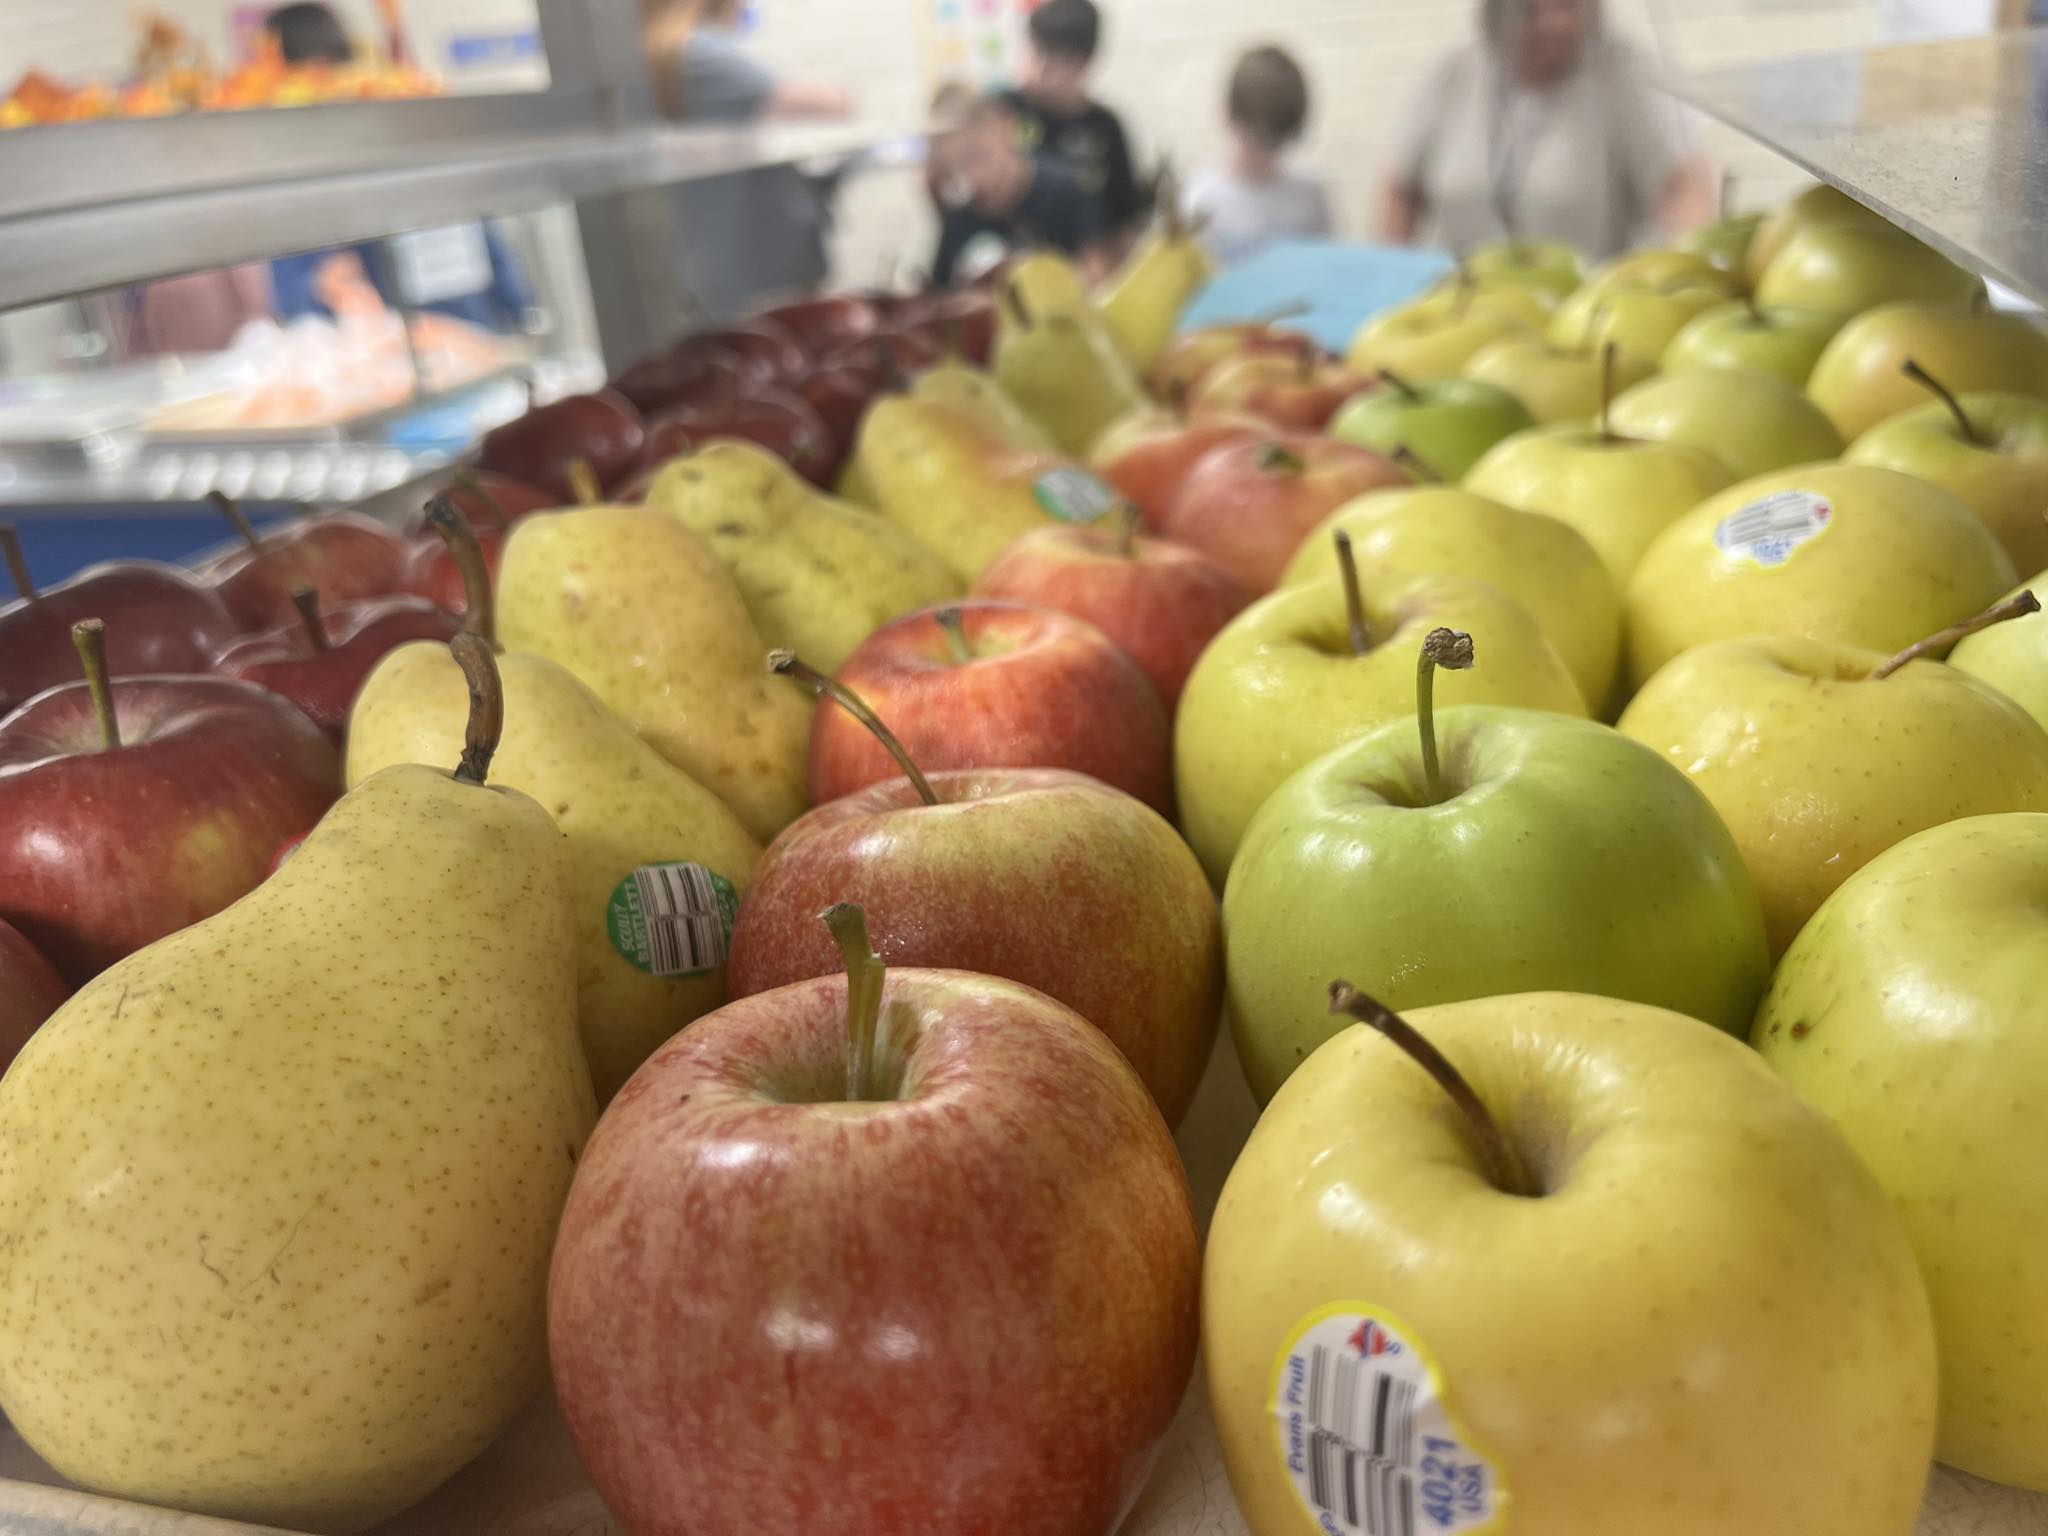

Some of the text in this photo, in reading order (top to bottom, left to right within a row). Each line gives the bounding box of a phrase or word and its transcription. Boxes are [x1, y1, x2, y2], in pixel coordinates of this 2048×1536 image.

[1286, 1354, 1305, 1406] Fruit
[1421, 1434, 1458, 1526] 4021
[1459, 1464, 1483, 1513] USA
